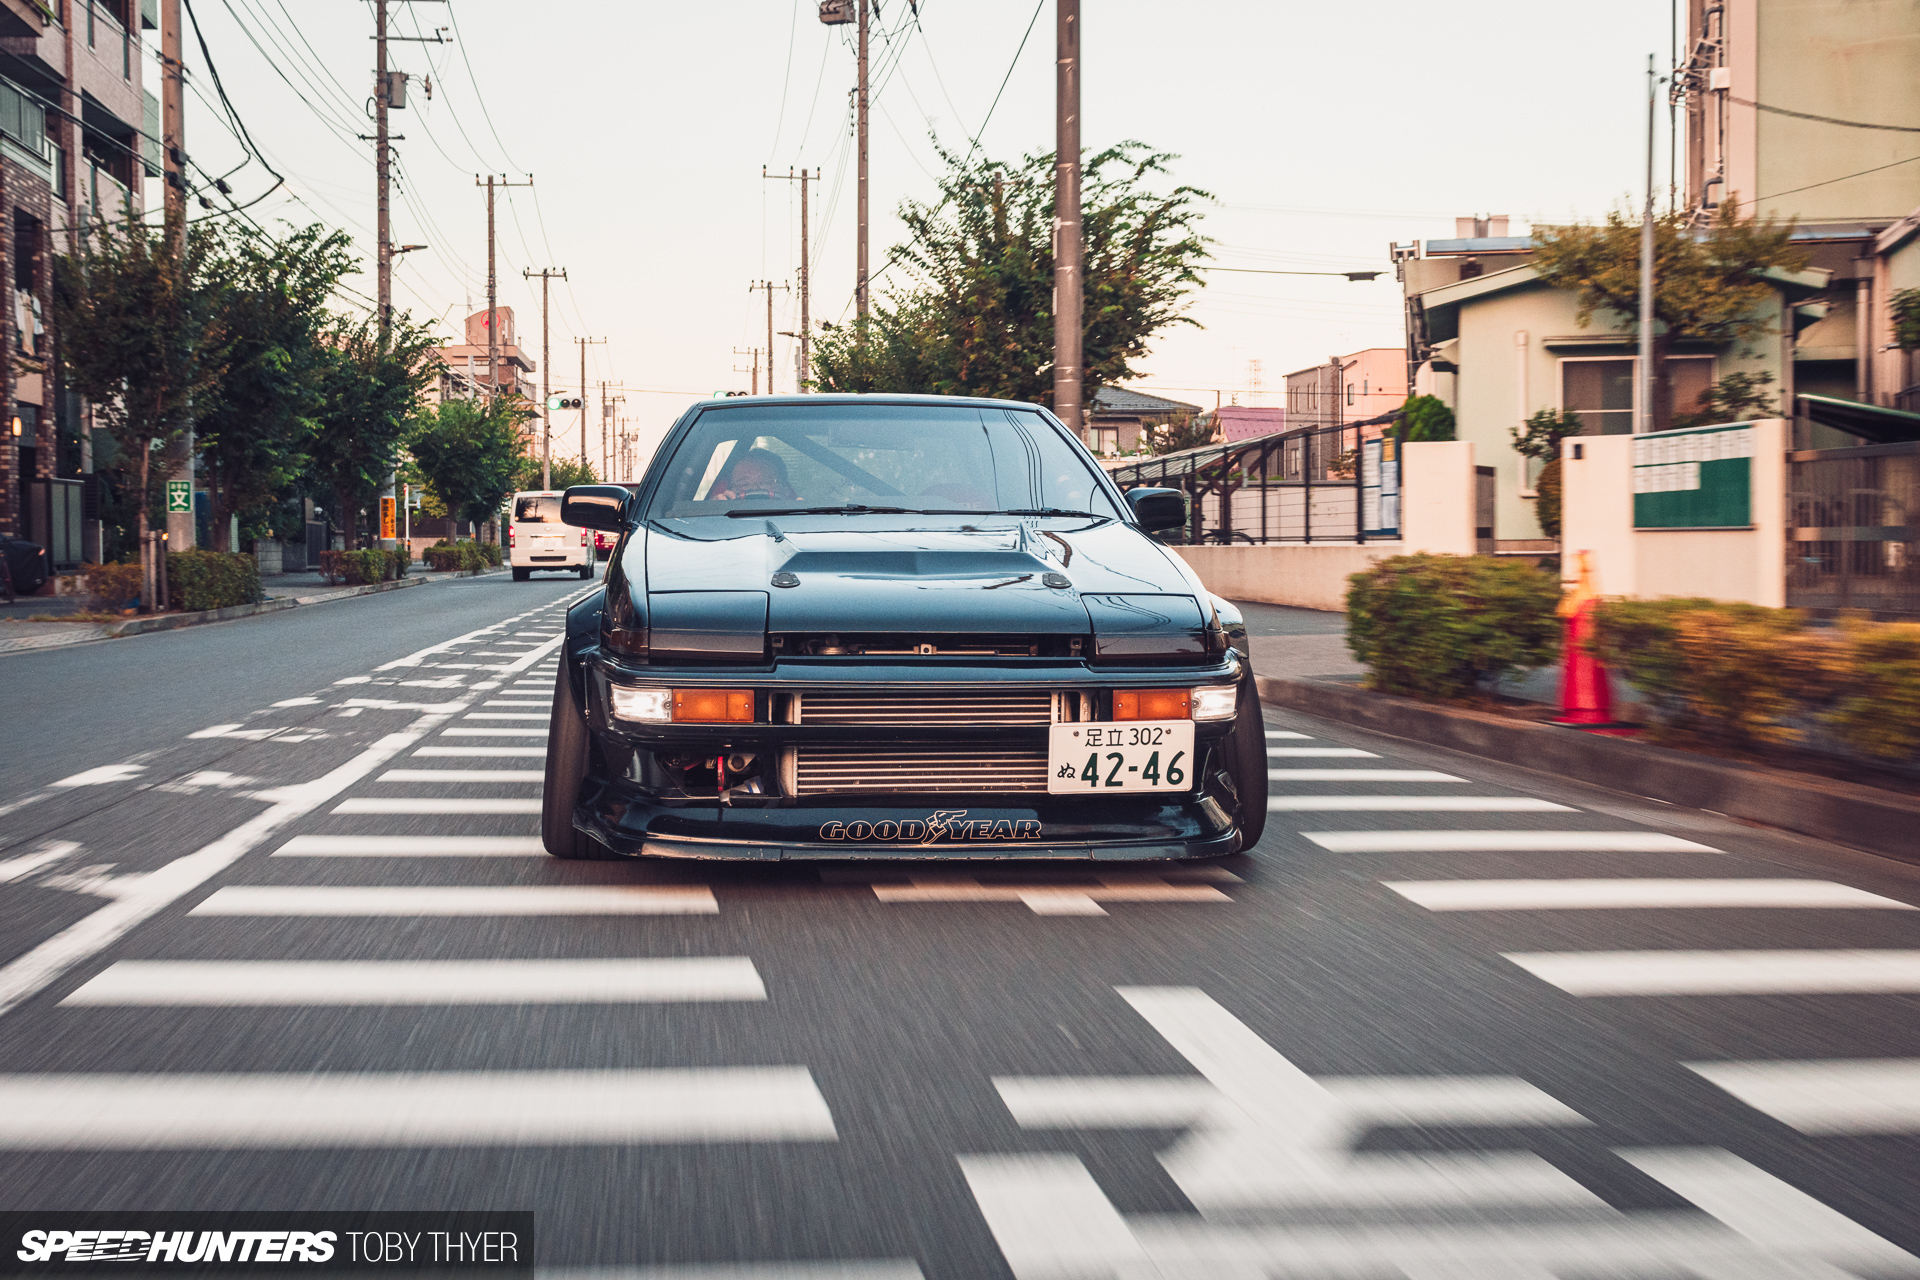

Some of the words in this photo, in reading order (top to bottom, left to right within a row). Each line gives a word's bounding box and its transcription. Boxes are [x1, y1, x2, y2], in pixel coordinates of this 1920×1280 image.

[1085, 728, 1124, 747] 足立
[1128, 727, 1163, 746] 302
[1057, 762, 1076, 779] ぬ
[1081, 750, 1186, 788] 42-46
